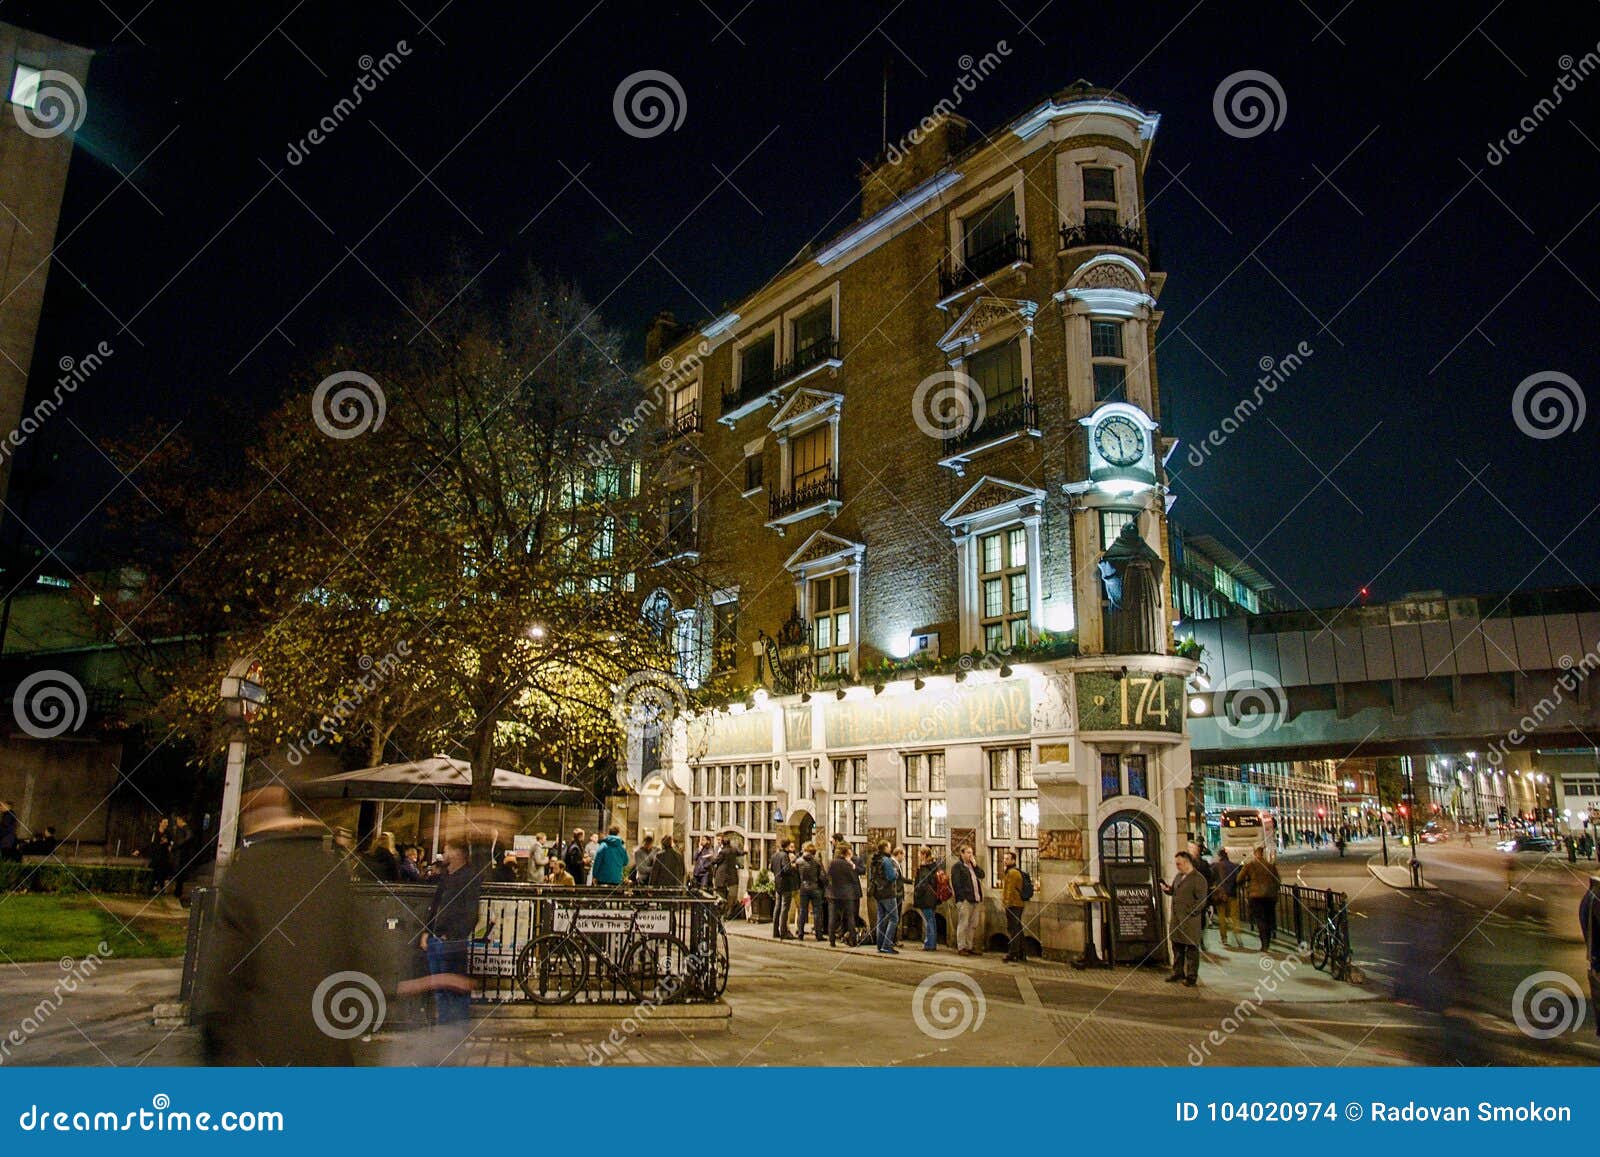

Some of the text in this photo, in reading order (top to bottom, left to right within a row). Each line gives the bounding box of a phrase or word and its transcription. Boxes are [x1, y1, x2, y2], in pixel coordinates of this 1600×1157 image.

[1120, 678, 1168, 726] 174
[631, 912, 667, 921] Rverside
[592, 921, 604, 929] Via
